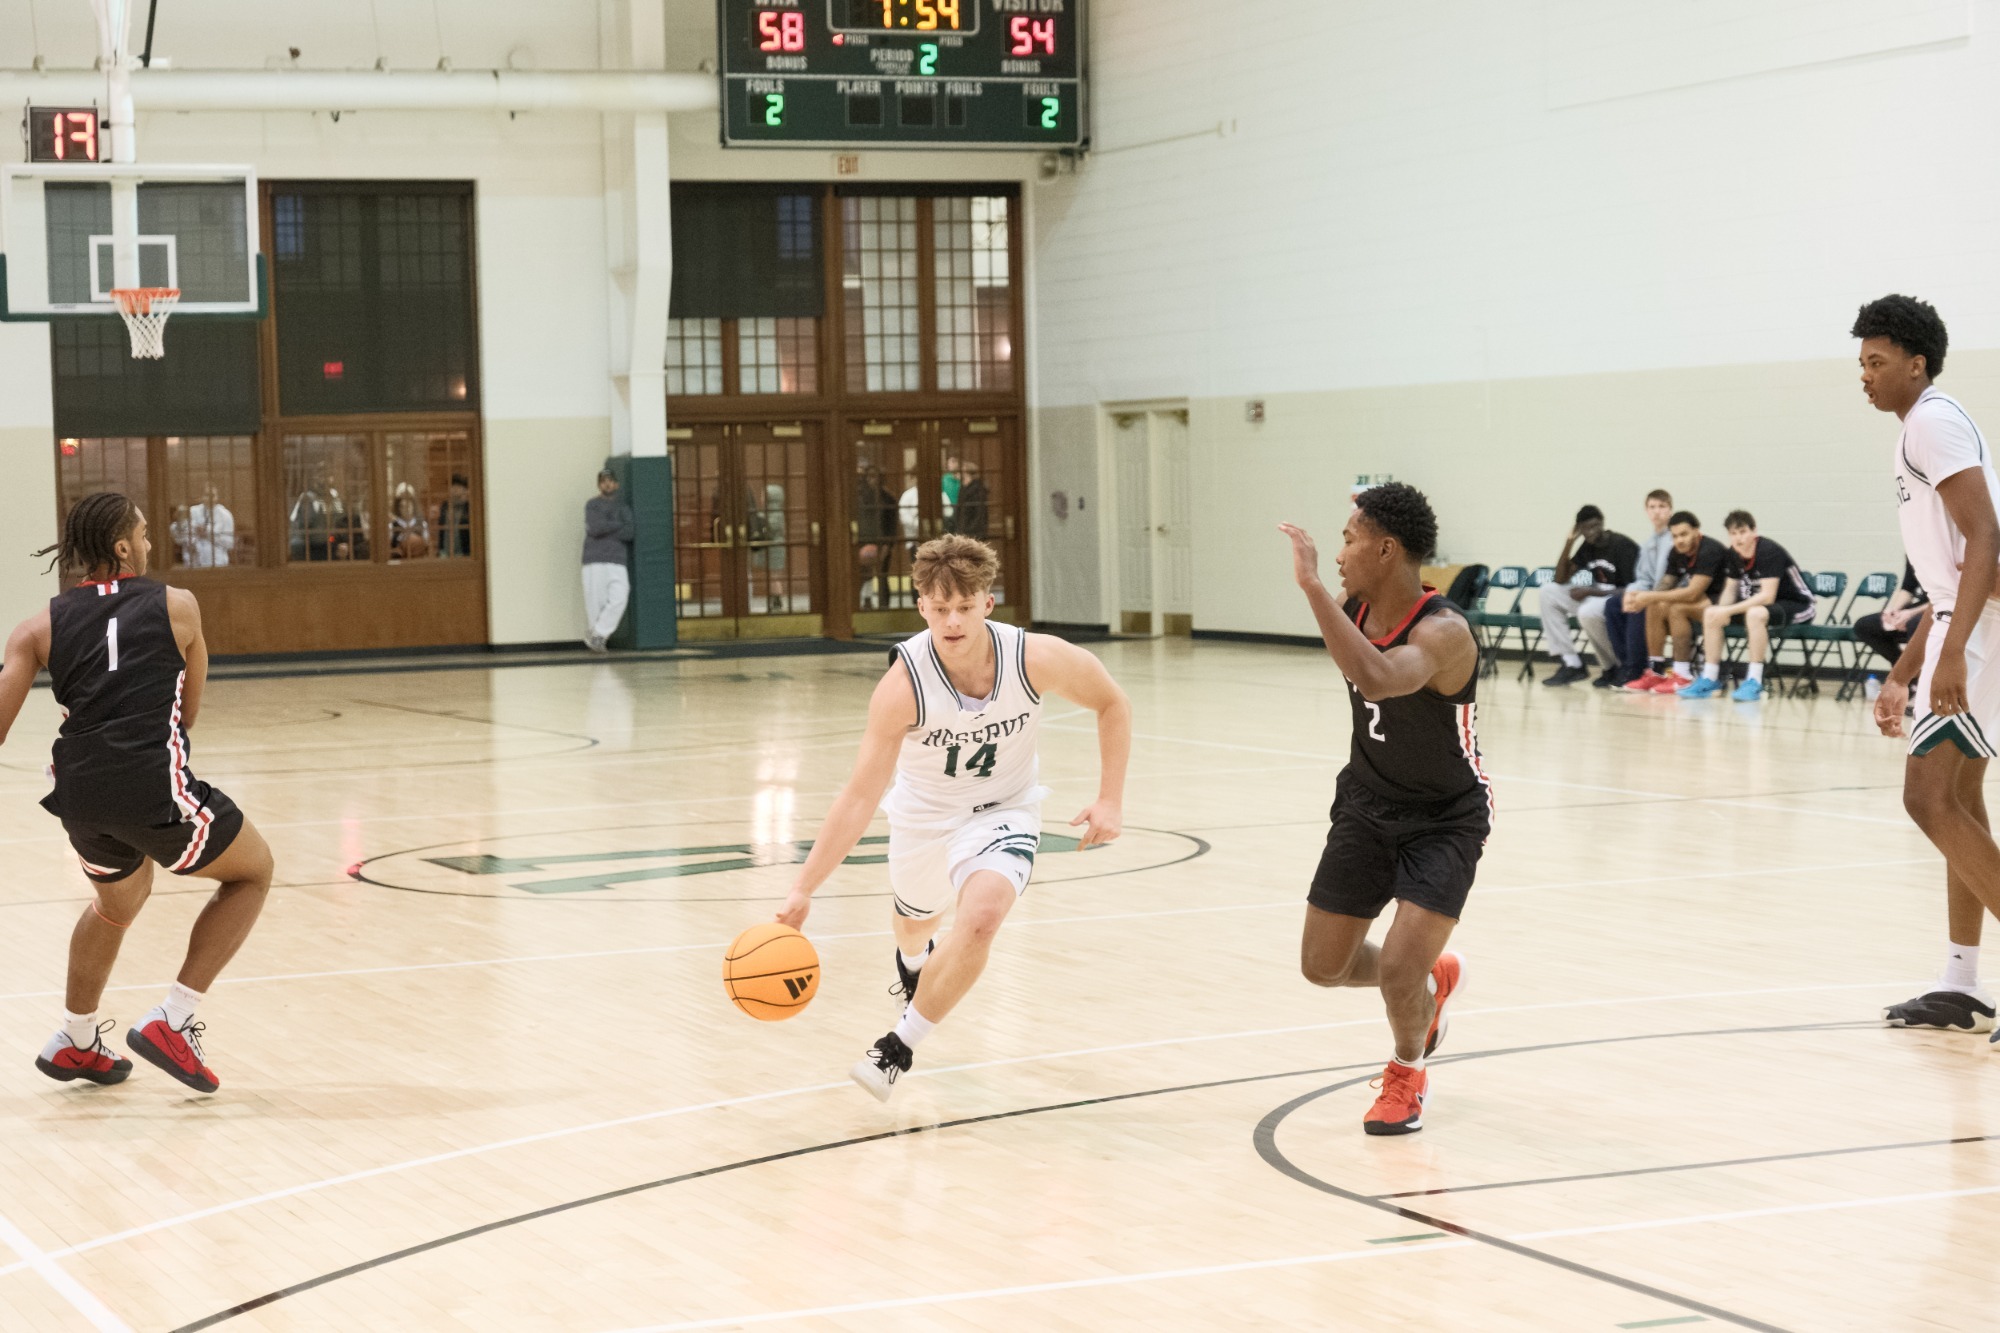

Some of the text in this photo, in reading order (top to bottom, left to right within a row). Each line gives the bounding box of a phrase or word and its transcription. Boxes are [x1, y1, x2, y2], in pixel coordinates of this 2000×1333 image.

[759, 12, 804, 51] 58
[1011, 17, 1055, 56] 54
[766, 55, 808, 70] BONUS
[869, 48, 915, 63] PERIOD
[919, 43, 938, 75] 2
[1001, 60, 1041, 74] BONUS
[746, 79, 784, 93] FOULS
[837, 80, 983, 95] PLAYER POINTS FOULS
[1022, 83, 1060, 95] FOULS
[766, 94, 784, 126] 2
[1041, 97, 1059, 128] 2
[106, 617, 119, 672] 1
[1363, 701, 1386, 742] 2
[944, 742, 998, 778] 14
